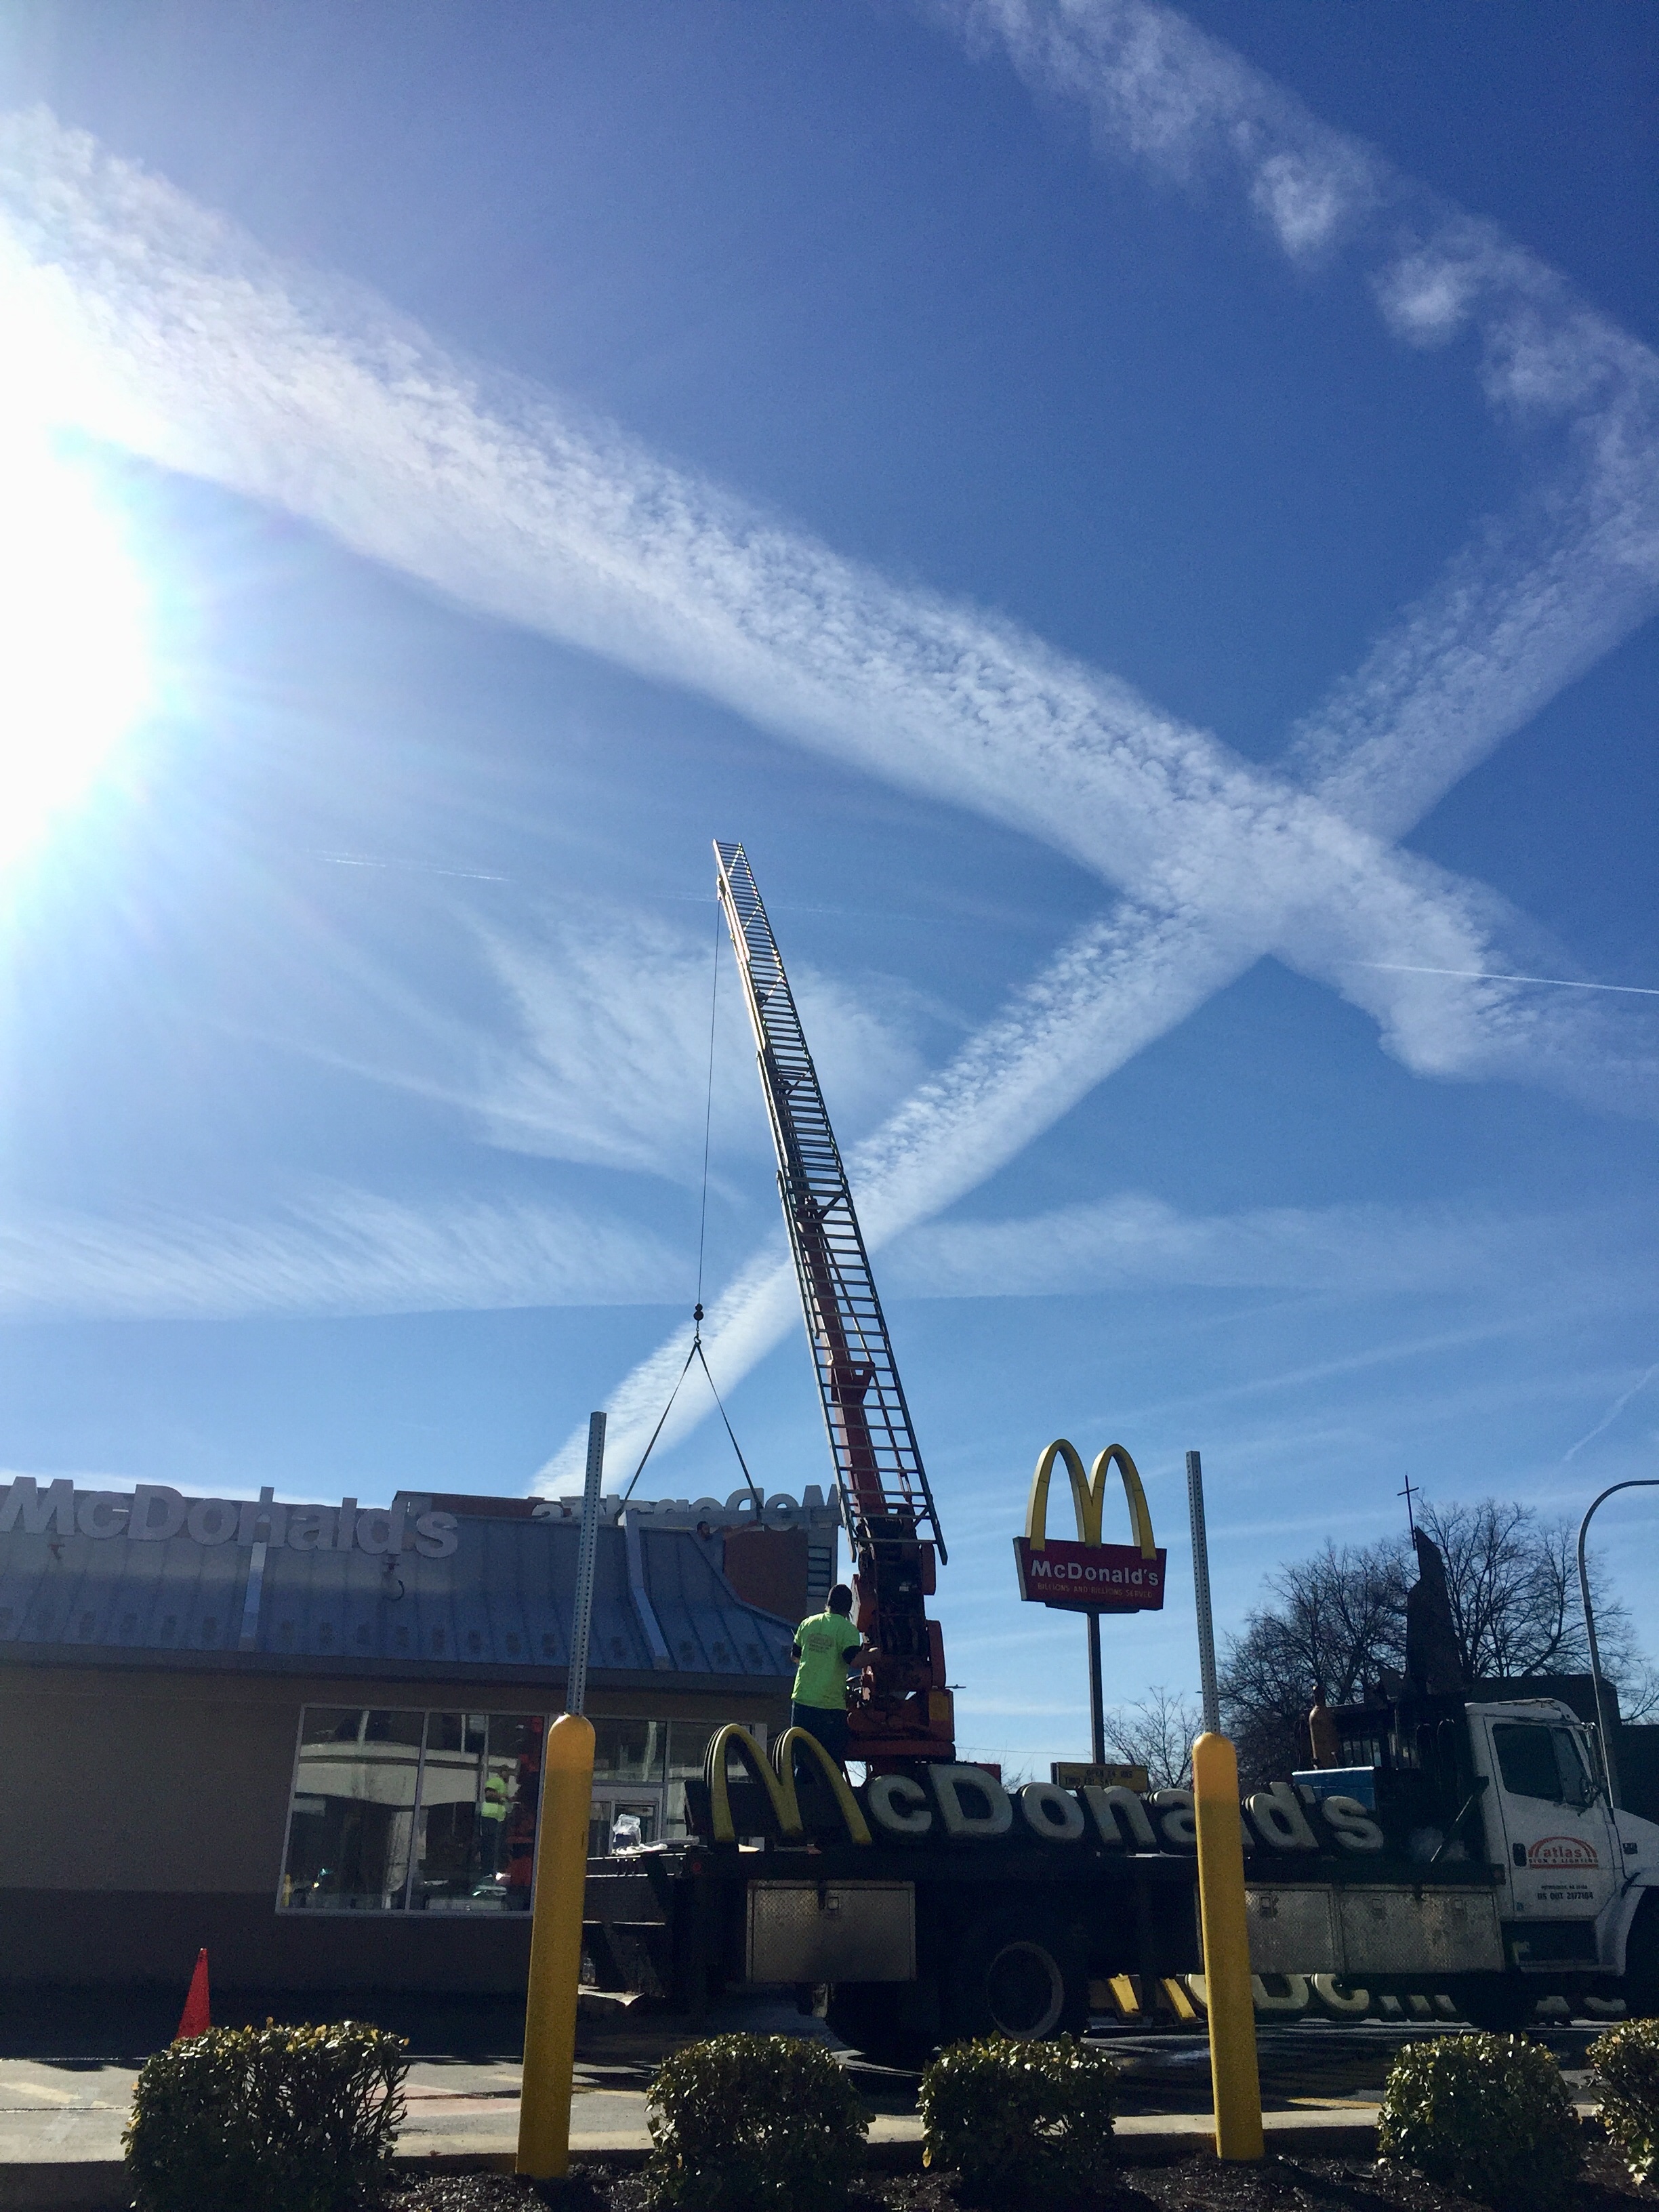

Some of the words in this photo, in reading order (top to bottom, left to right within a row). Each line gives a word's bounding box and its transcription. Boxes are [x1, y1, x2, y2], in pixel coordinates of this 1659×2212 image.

[0, 1476, 458, 1558] McDonald's
[1031, 1559, 1159, 1586] McDonald's
[1038, 1582, 1069, 1593] BILLIONS
[1091, 1586, 1123, 1597] BILLIONS
[1126, 1589, 1153, 1598] SERVED
[703, 1723, 1384, 1857] McDonad's
[1542, 1845, 1582, 1858] atlas
